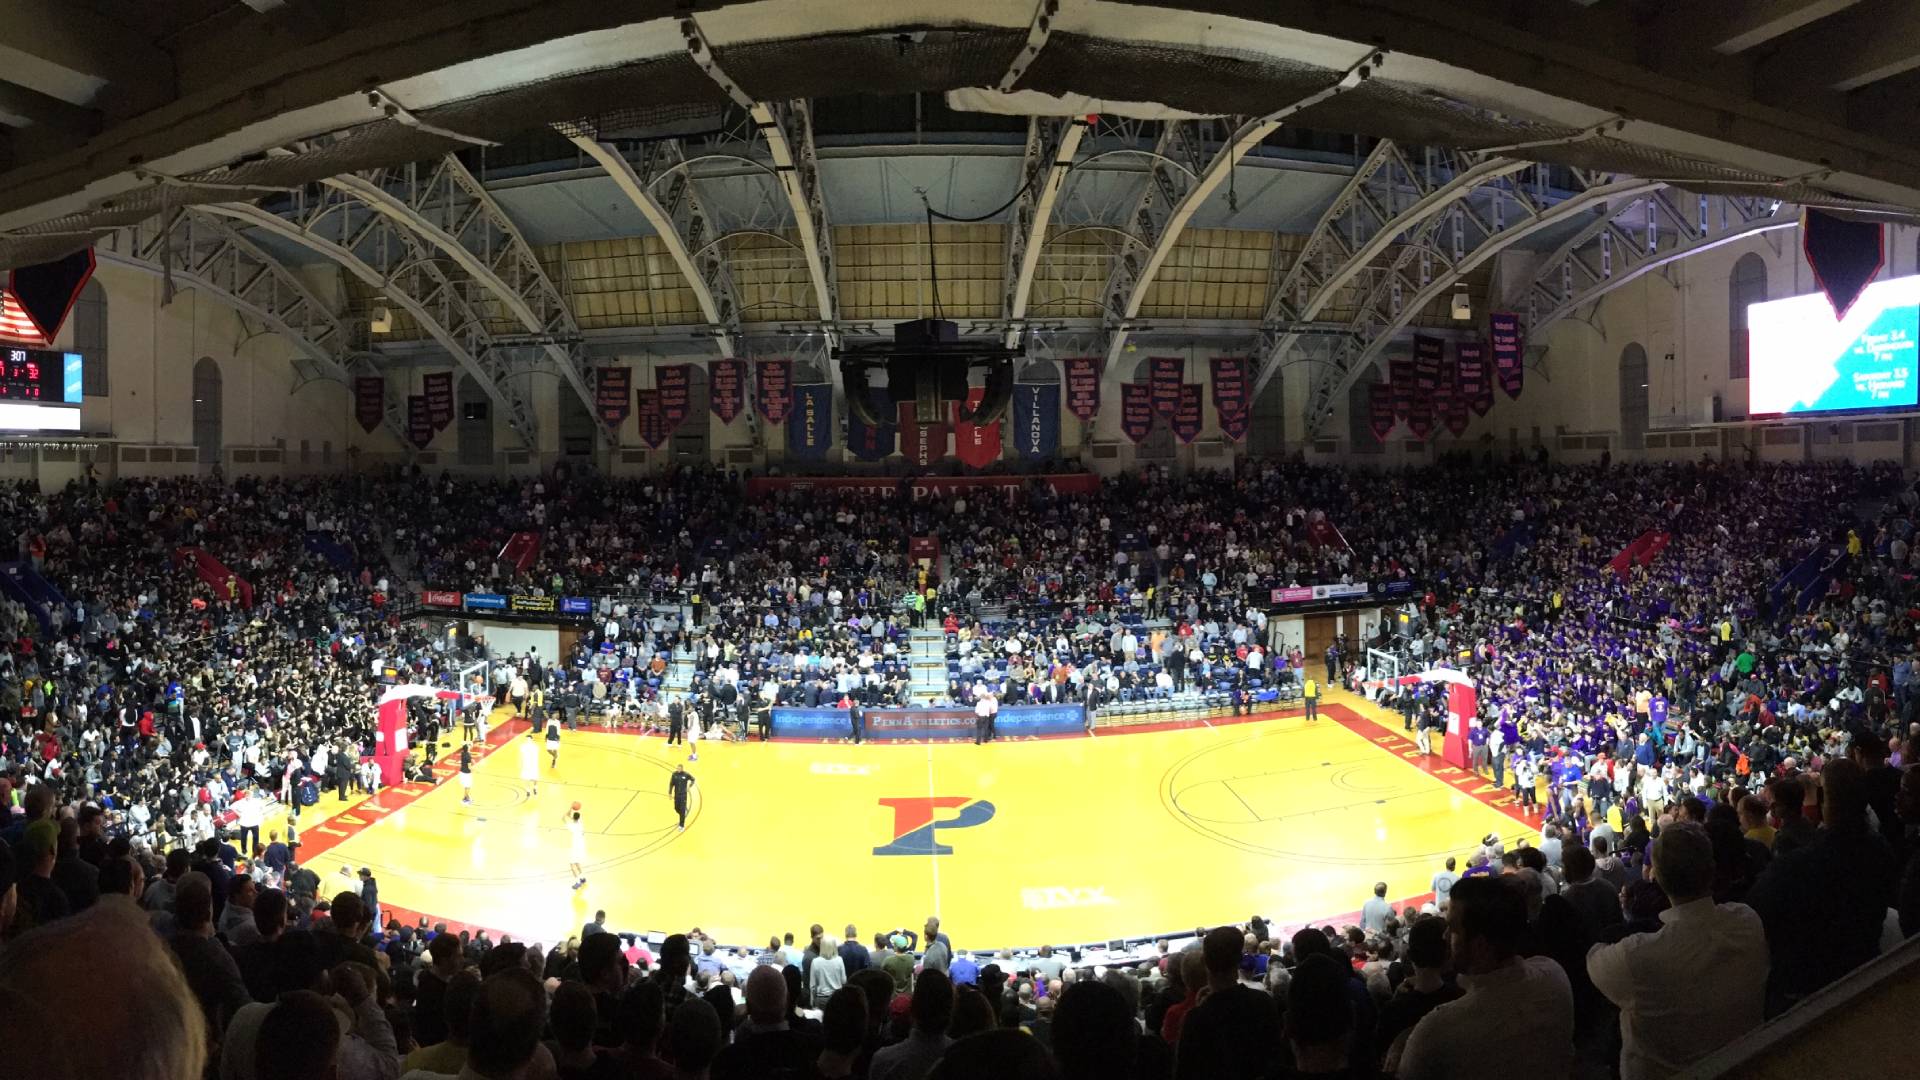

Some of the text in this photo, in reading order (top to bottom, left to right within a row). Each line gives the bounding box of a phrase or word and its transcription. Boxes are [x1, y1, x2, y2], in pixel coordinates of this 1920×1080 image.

[1030, 385, 1040, 454] VILLANOVA
[911, 482, 1058, 504] PATA
[774, 713, 847, 726] Independence
[994, 711, 1066, 724] ndependence
[318, 801, 391, 838] IVY
[872, 796, 996, 856] P
